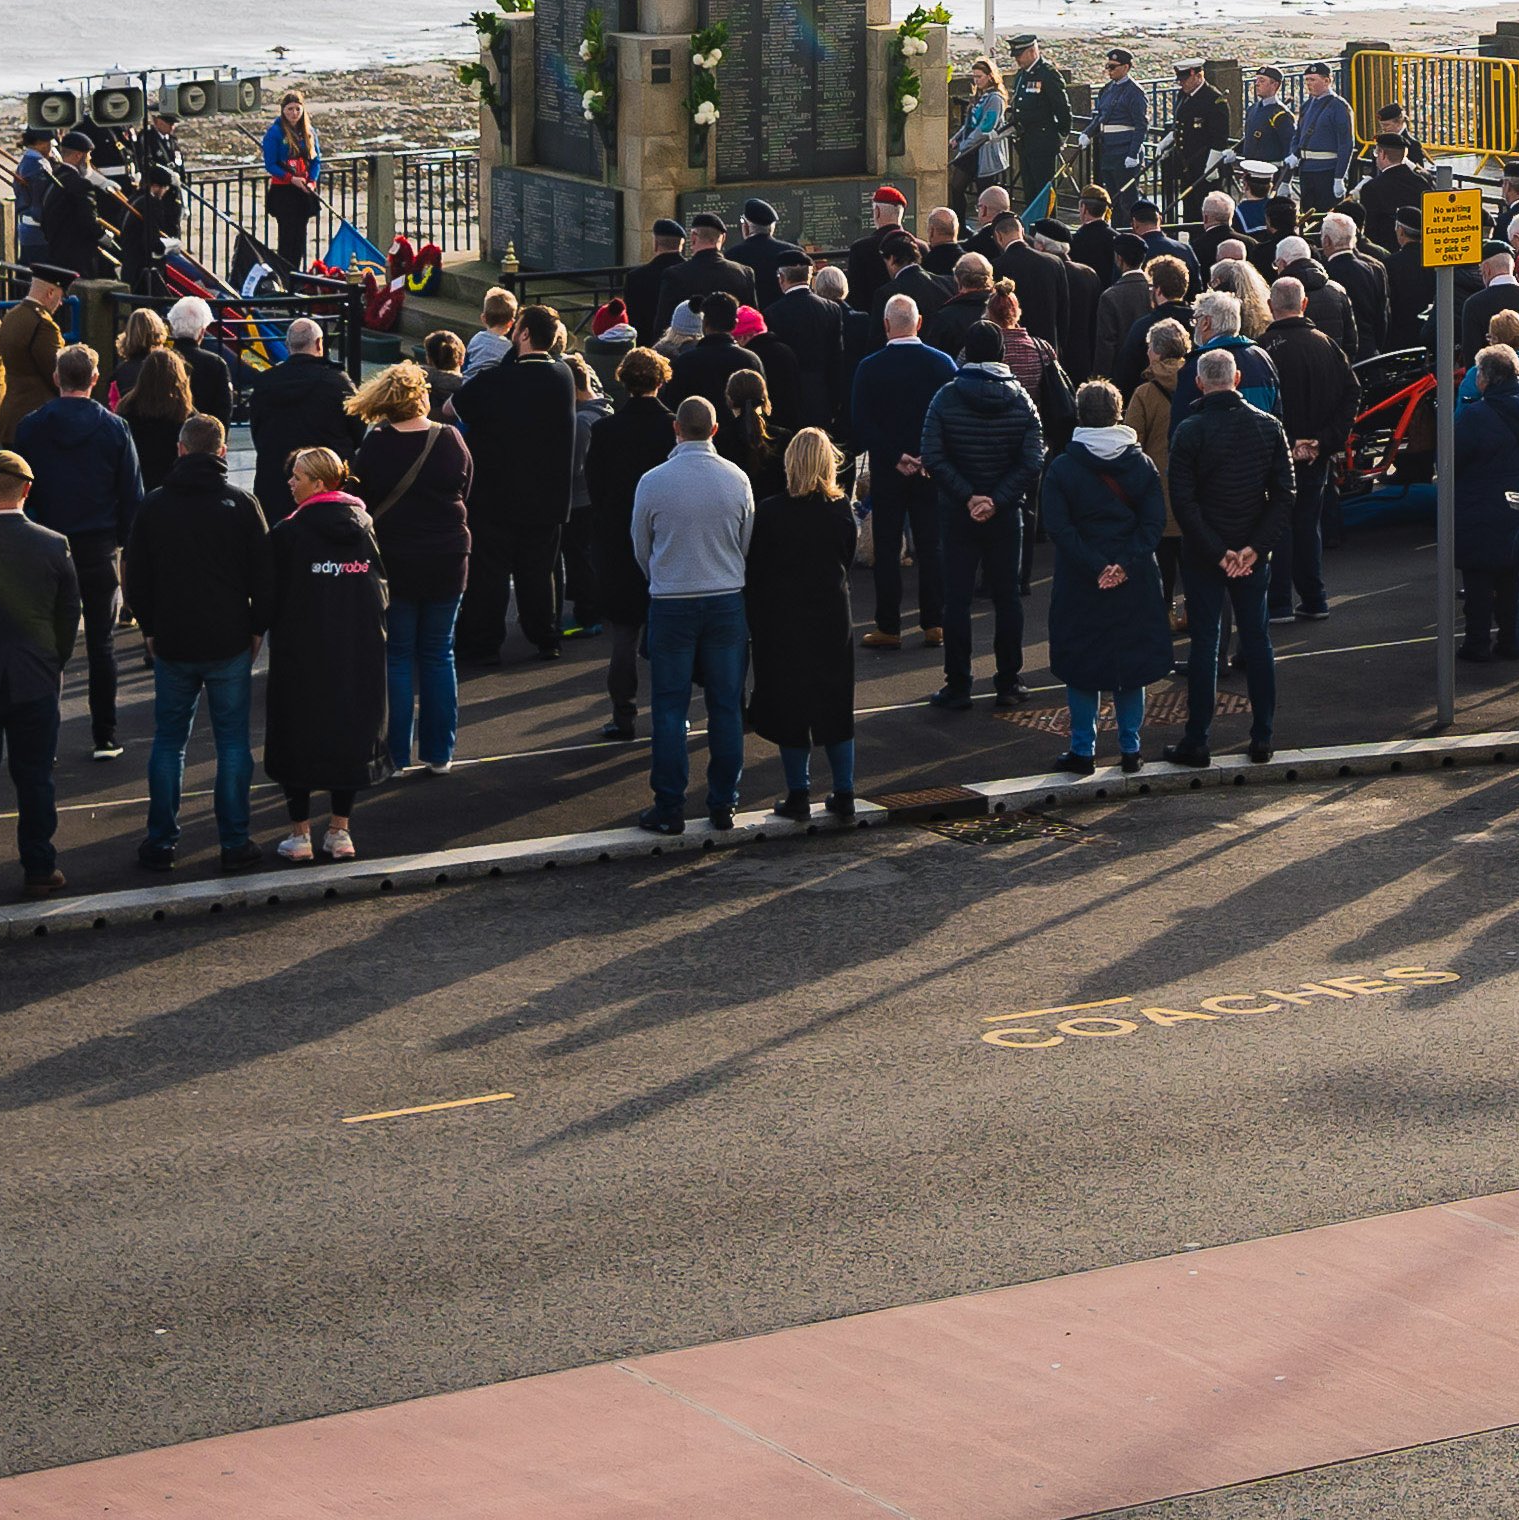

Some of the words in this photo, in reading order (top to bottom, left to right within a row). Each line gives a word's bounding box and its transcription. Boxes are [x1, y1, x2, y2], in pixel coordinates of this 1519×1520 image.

[1433, 206, 1444, 214] No
[1446, 205, 1471, 214] waiting
[1426, 226, 1450, 235] Except
[1451, 224, 1479, 233] coaches
[1461, 235, 1471, 243] off
[1442, 253, 1463, 262] ONLY
[321, 560, 369, 577] dryrobe
[980, 964, 1461, 1050] COACHES
